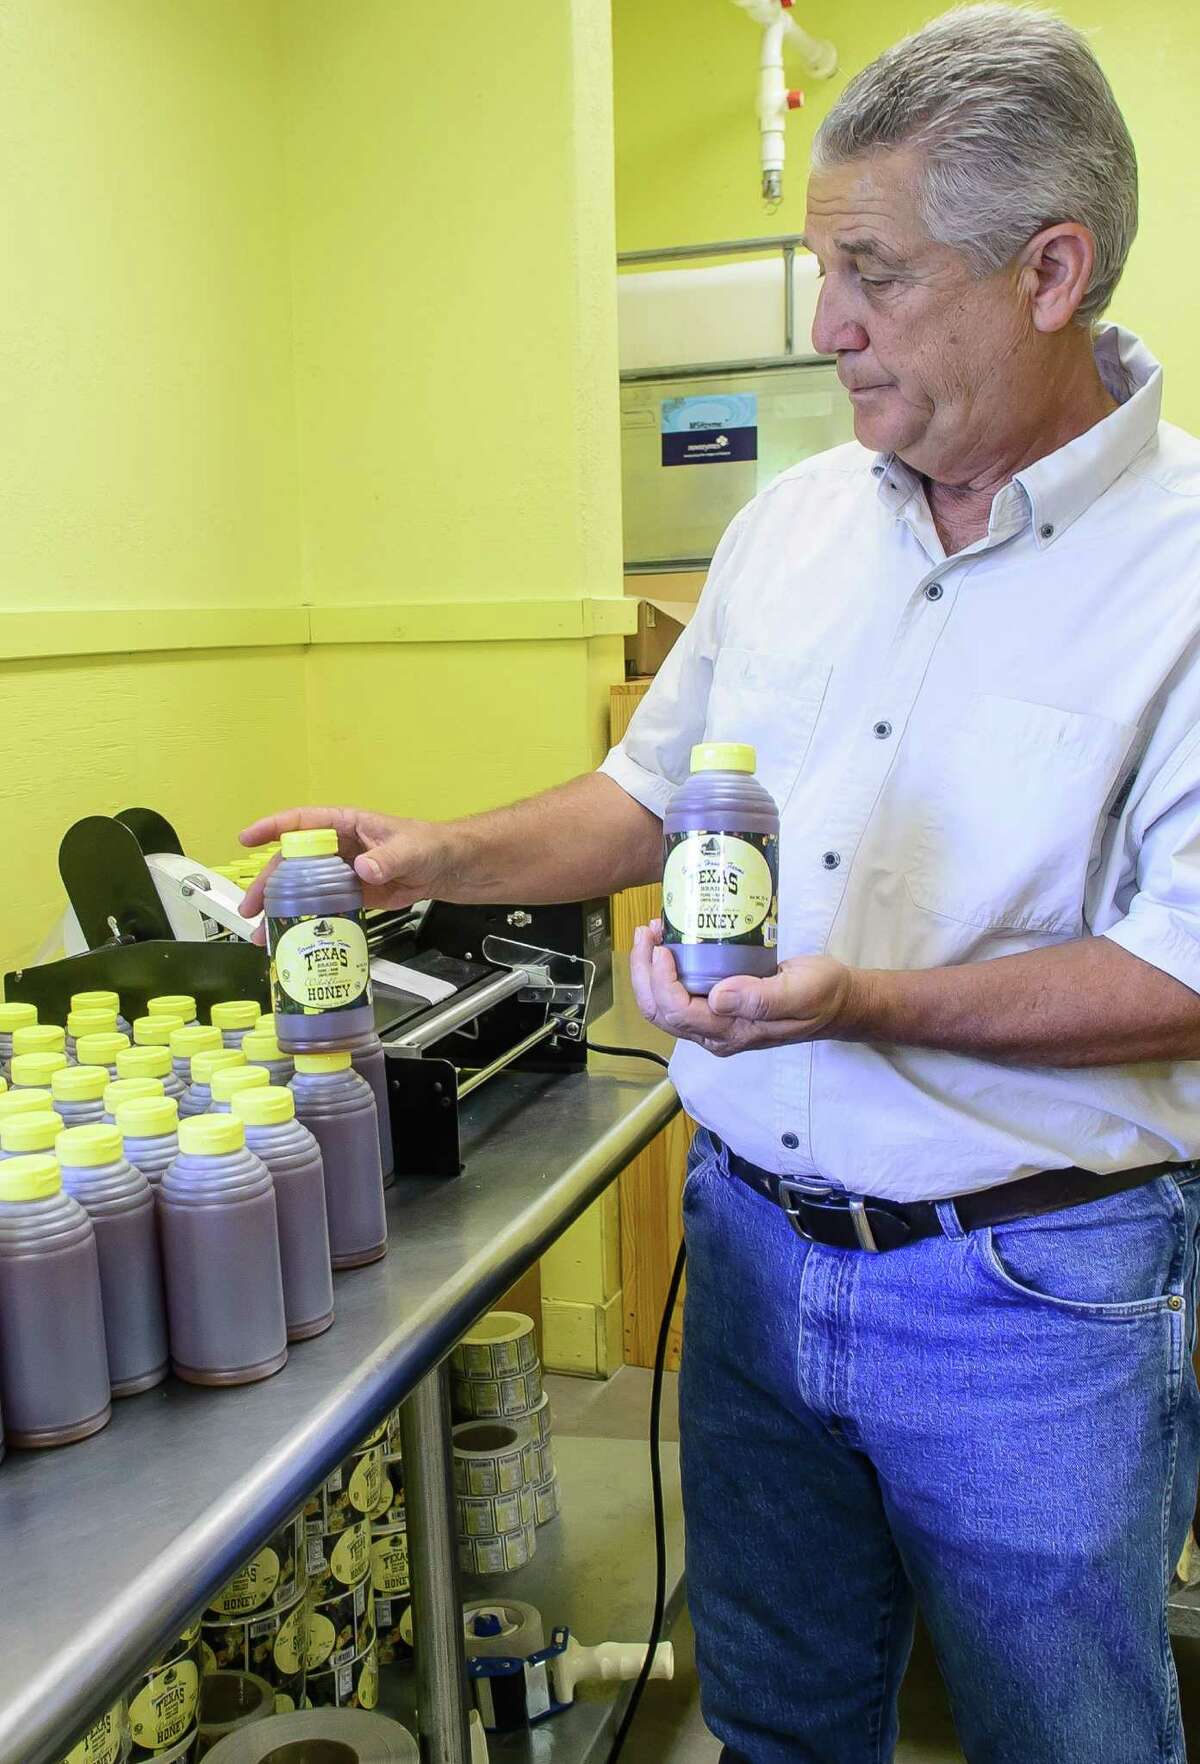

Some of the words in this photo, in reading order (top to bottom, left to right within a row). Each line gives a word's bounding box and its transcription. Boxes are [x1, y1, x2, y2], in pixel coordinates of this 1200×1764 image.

[692, 869, 738, 896] EXAS
[692, 913, 739, 929] ONEY
[304, 947, 348, 972] TEXAS
[307, 983, 351, 1001] HONEY
[384, 1576, 408, 1589] HONE
[223, 1594, 257, 1611] HONEY
[155, 1687, 185, 1718] TEXAS
[157, 1716, 186, 1745] HONEY
